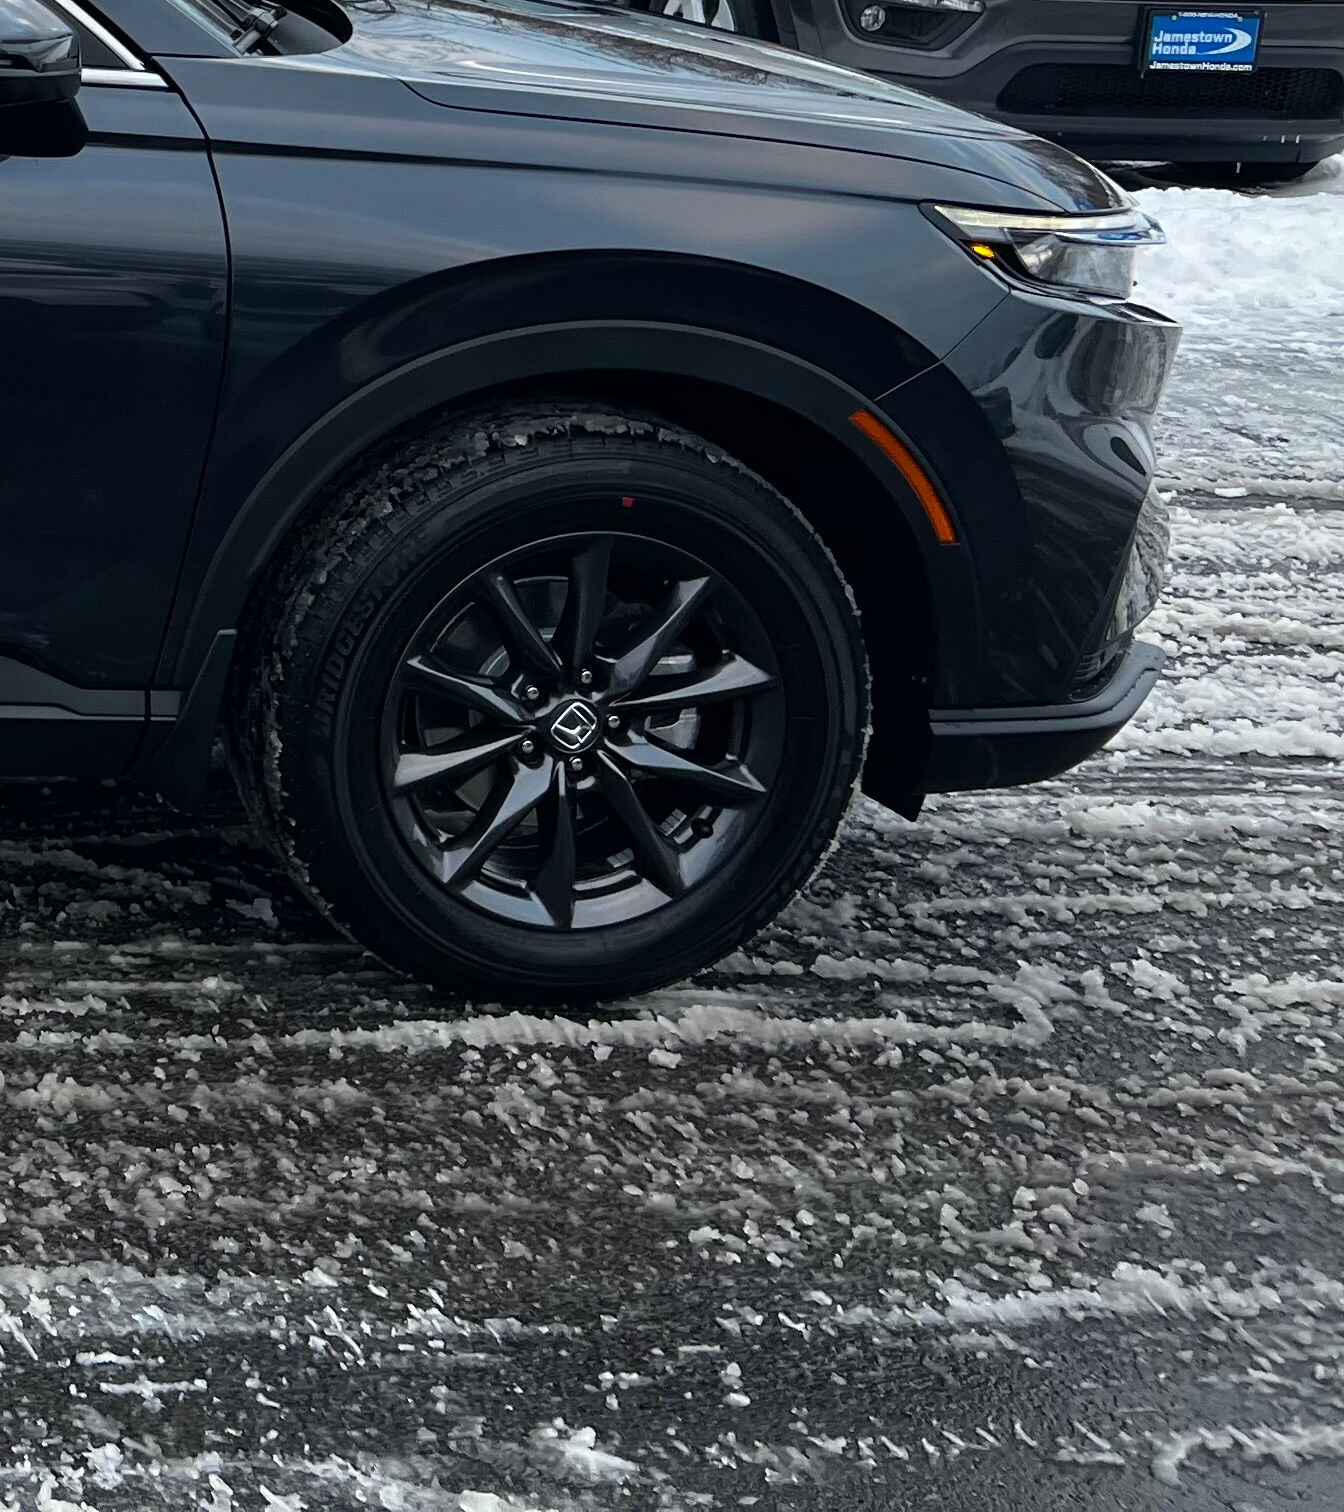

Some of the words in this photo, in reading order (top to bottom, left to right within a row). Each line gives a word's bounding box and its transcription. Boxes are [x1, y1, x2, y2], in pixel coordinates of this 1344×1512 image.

[1153, 30, 1233, 44] Jamestown
[1151, 42, 1197, 56] Honda
[1149, 60, 1253, 72] JamestownHonda.com
